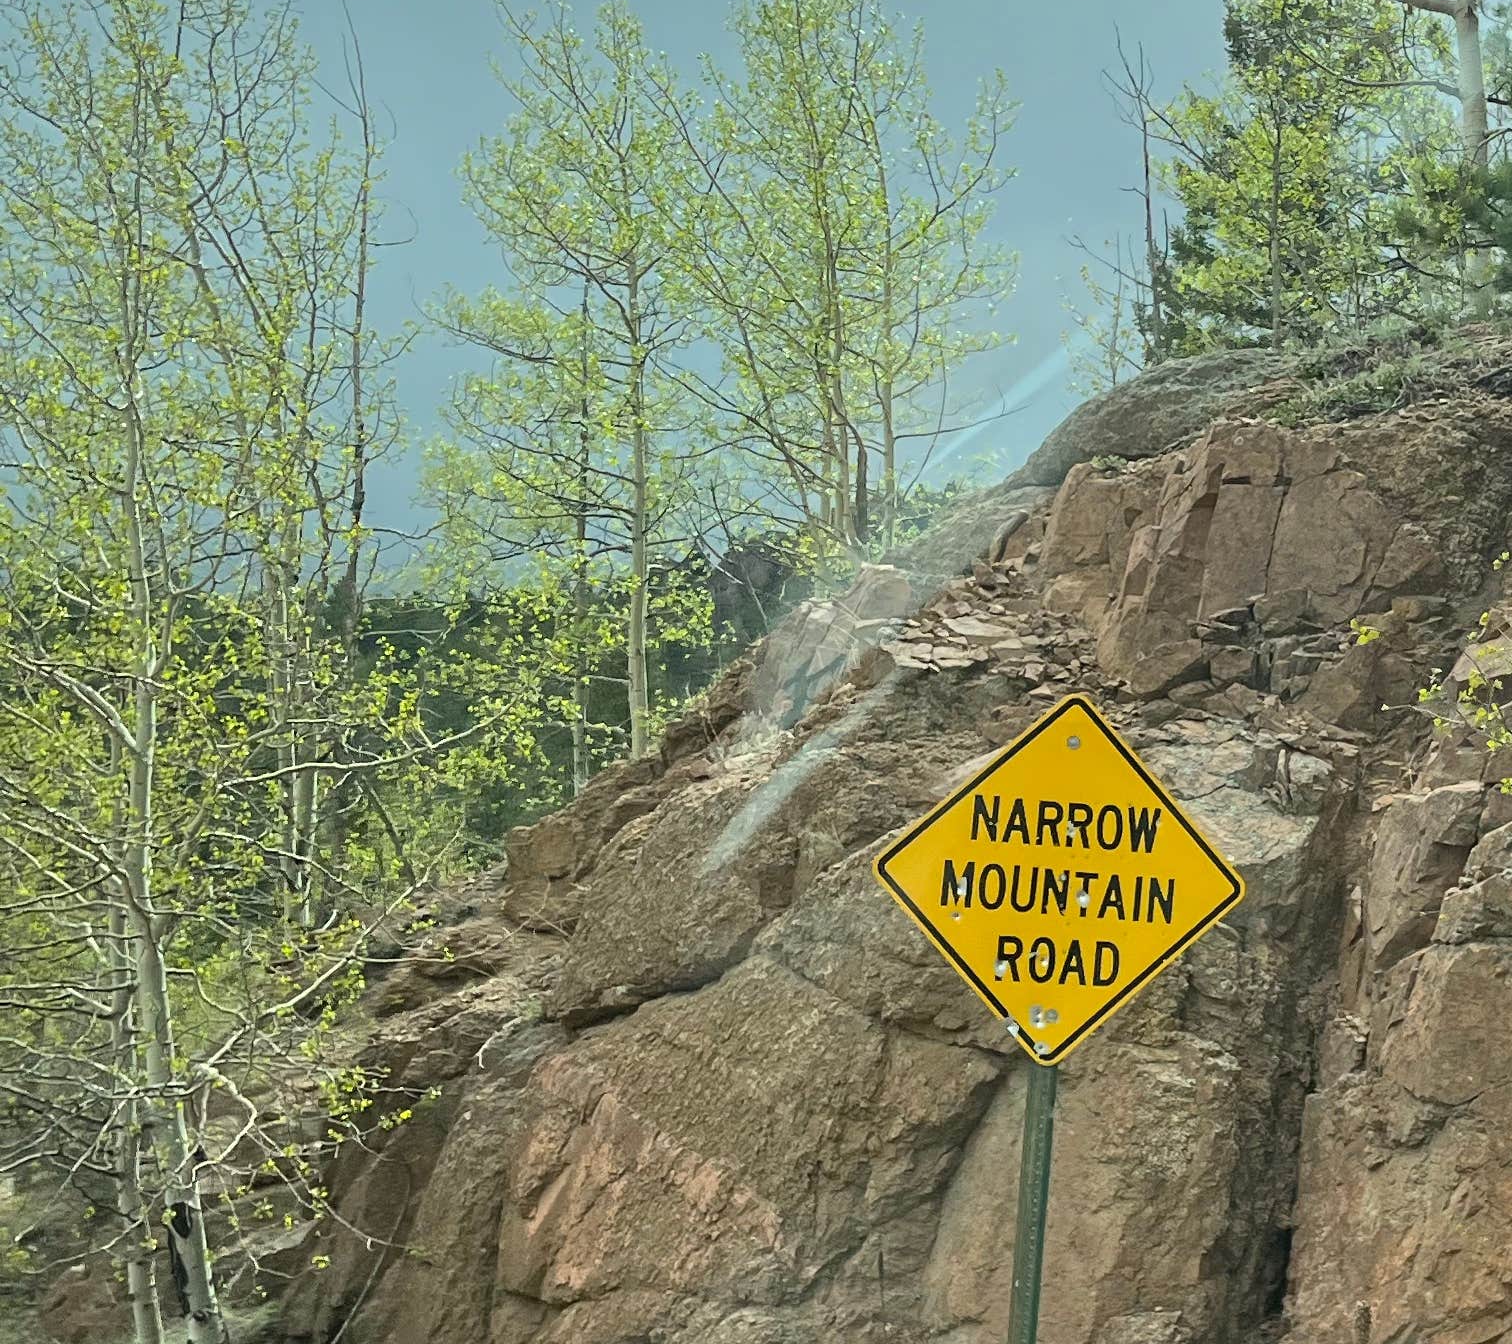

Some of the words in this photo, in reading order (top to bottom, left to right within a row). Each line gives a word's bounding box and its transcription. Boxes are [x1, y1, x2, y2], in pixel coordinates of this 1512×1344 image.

[970, 794, 1162, 854] NARROW
[940, 859, 1175, 925] MOUNTAIN
[994, 935, 1121, 987] ROAD
